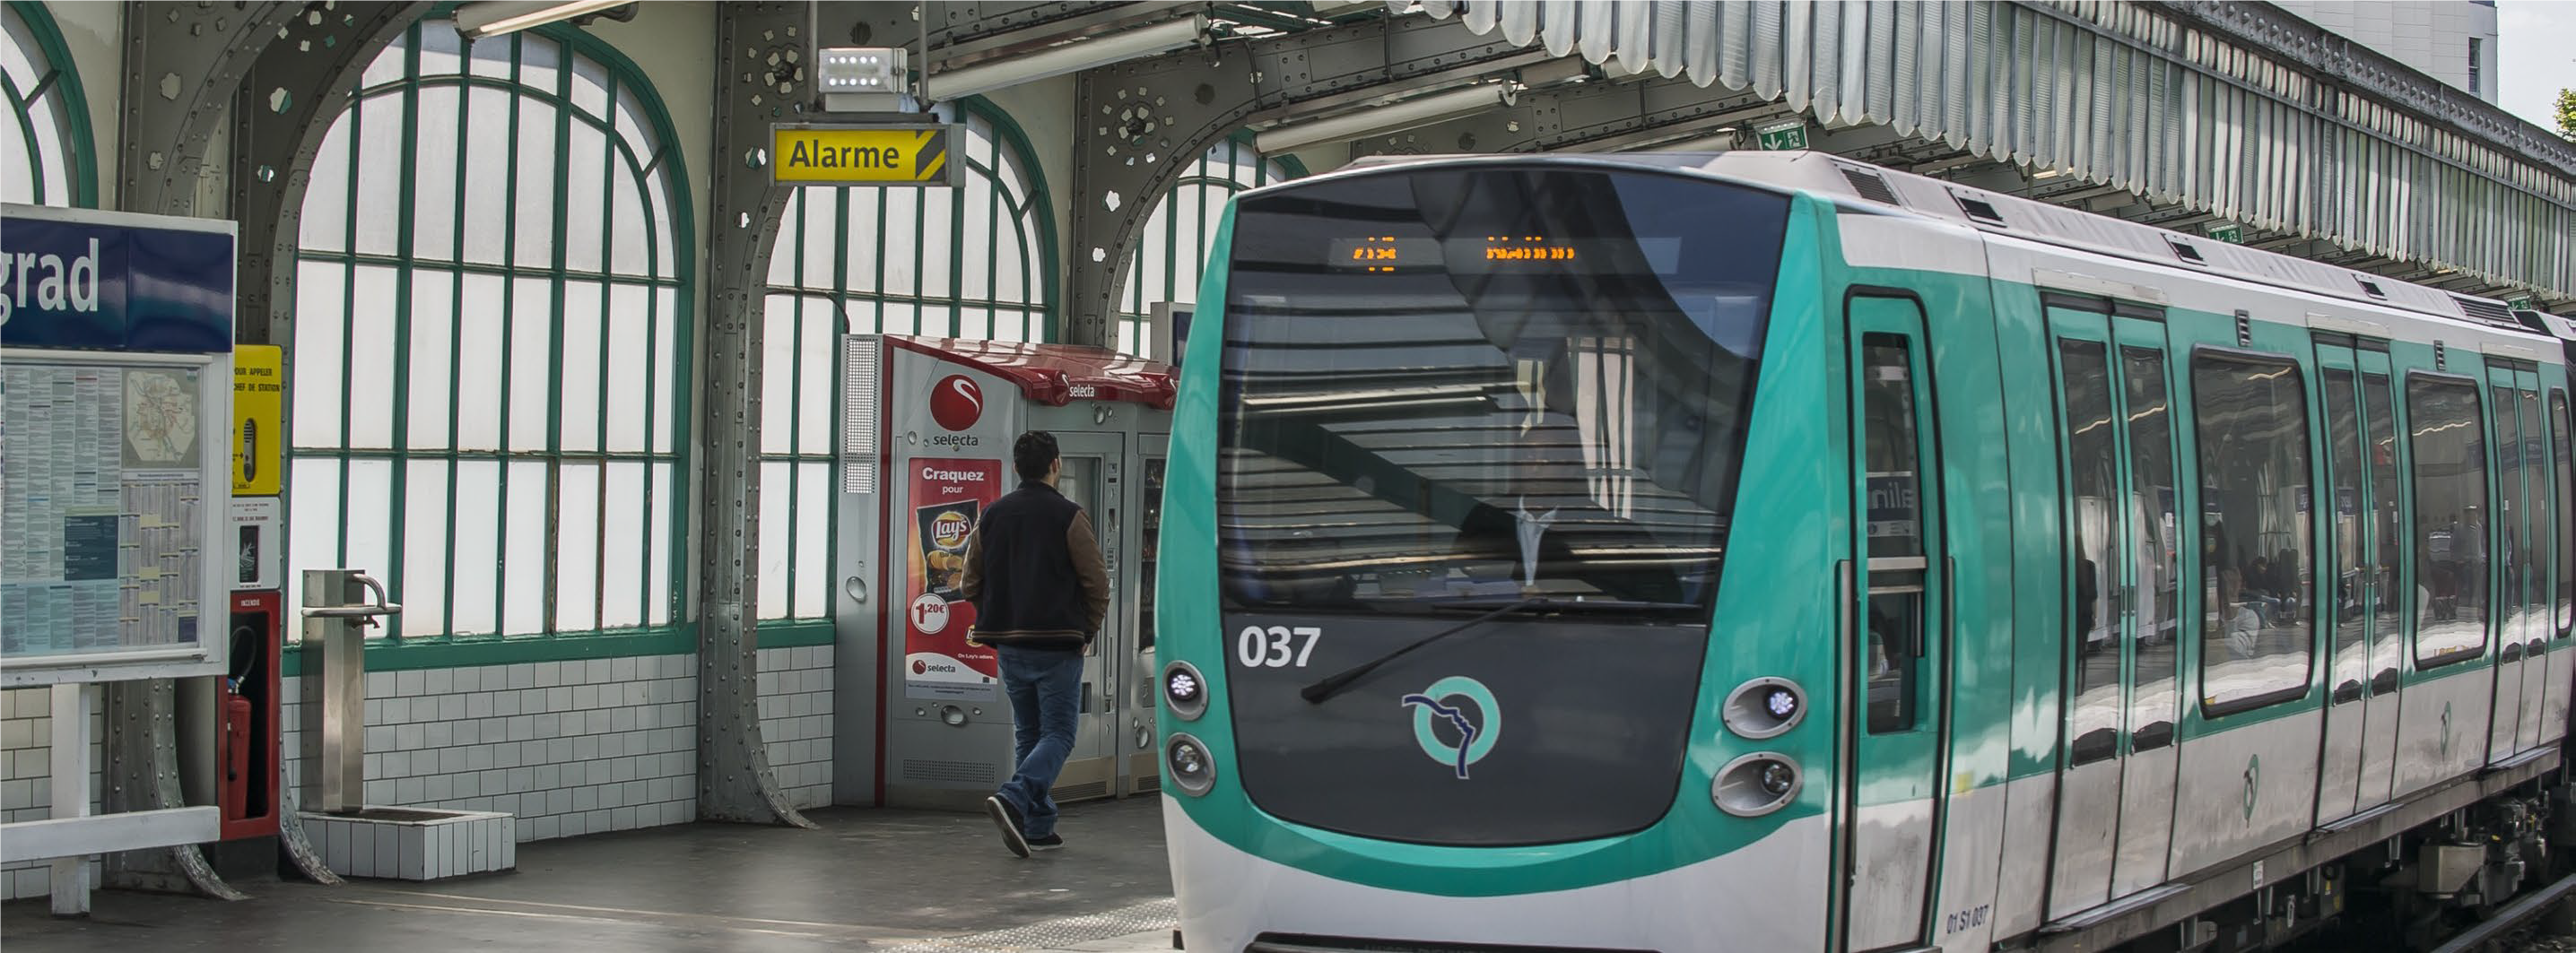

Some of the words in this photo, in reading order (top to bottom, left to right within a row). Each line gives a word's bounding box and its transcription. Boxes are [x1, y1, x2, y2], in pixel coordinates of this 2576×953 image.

[788, 139, 900, 169] Alarme
[234, 367, 247, 376] OUR
[248, 384, 256, 392] DE
[257, 384, 280, 393] STATION
[1069, 383, 1095, 398] selecta
[933, 434, 979, 446] selecta
[922, 467, 985, 483] Craquez
[942, 485, 964, 495] pour
[916, 603, 945, 625] 1,20€
[1239, 626, 1321, 667] 037
[927, 663, 956, 673] selecta
[1946, 913, 1958, 934] 01
[1959, 910, 1971, 931] S1
[1972, 904, 1989, 927] 037
